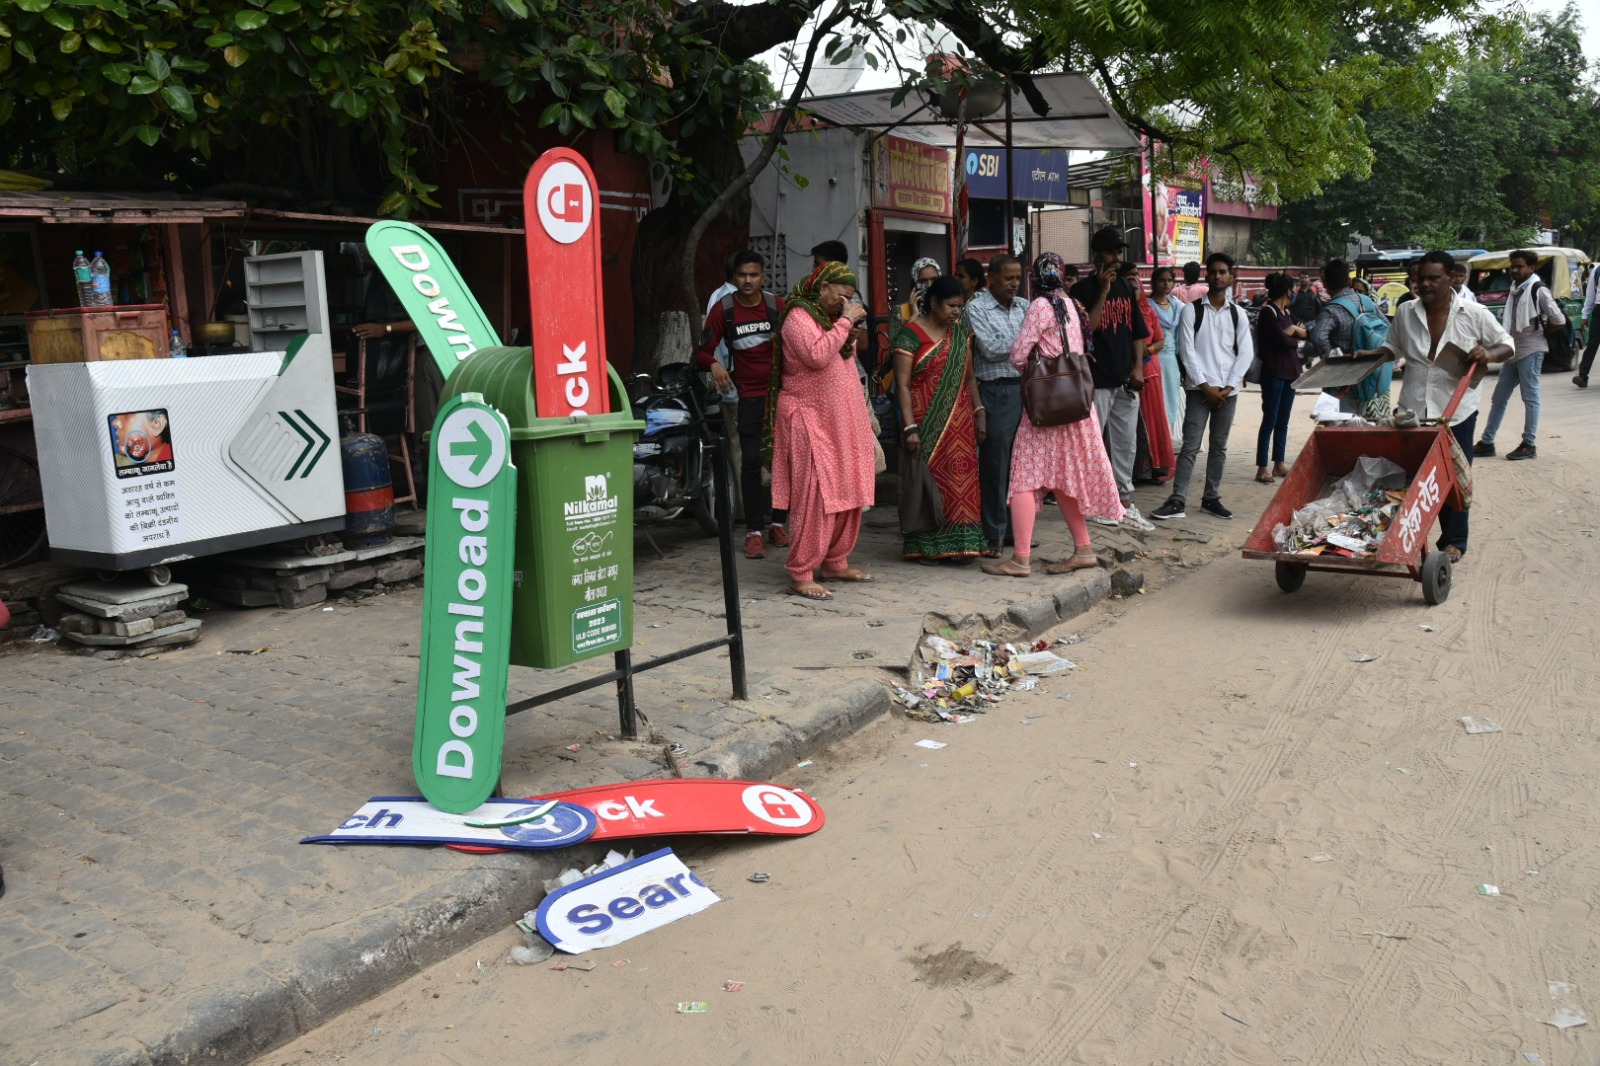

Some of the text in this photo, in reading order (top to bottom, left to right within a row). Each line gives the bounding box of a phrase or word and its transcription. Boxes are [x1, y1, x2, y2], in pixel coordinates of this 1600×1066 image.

[978, 153, 999, 178] SBI
[1047, 172, 1060, 182] ATM
[736, 321, 771, 335] NIKEPRO
[556, 340, 590, 417] ck
[144, 481, 155, 491] वर्ष
[156, 480, 163, 488] से
[142, 494, 155, 503] वाले
[564, 495, 618, 515] Nilkamal
[125, 510, 135, 519] को
[129, 522, 140, 531] की
[142, 529, 171, 542] अपराध है
[436, 498, 490, 780] Download
[575, 632, 587, 642] ULB
[586, 627, 601, 638] CODE
[596, 796, 664, 820] ck
